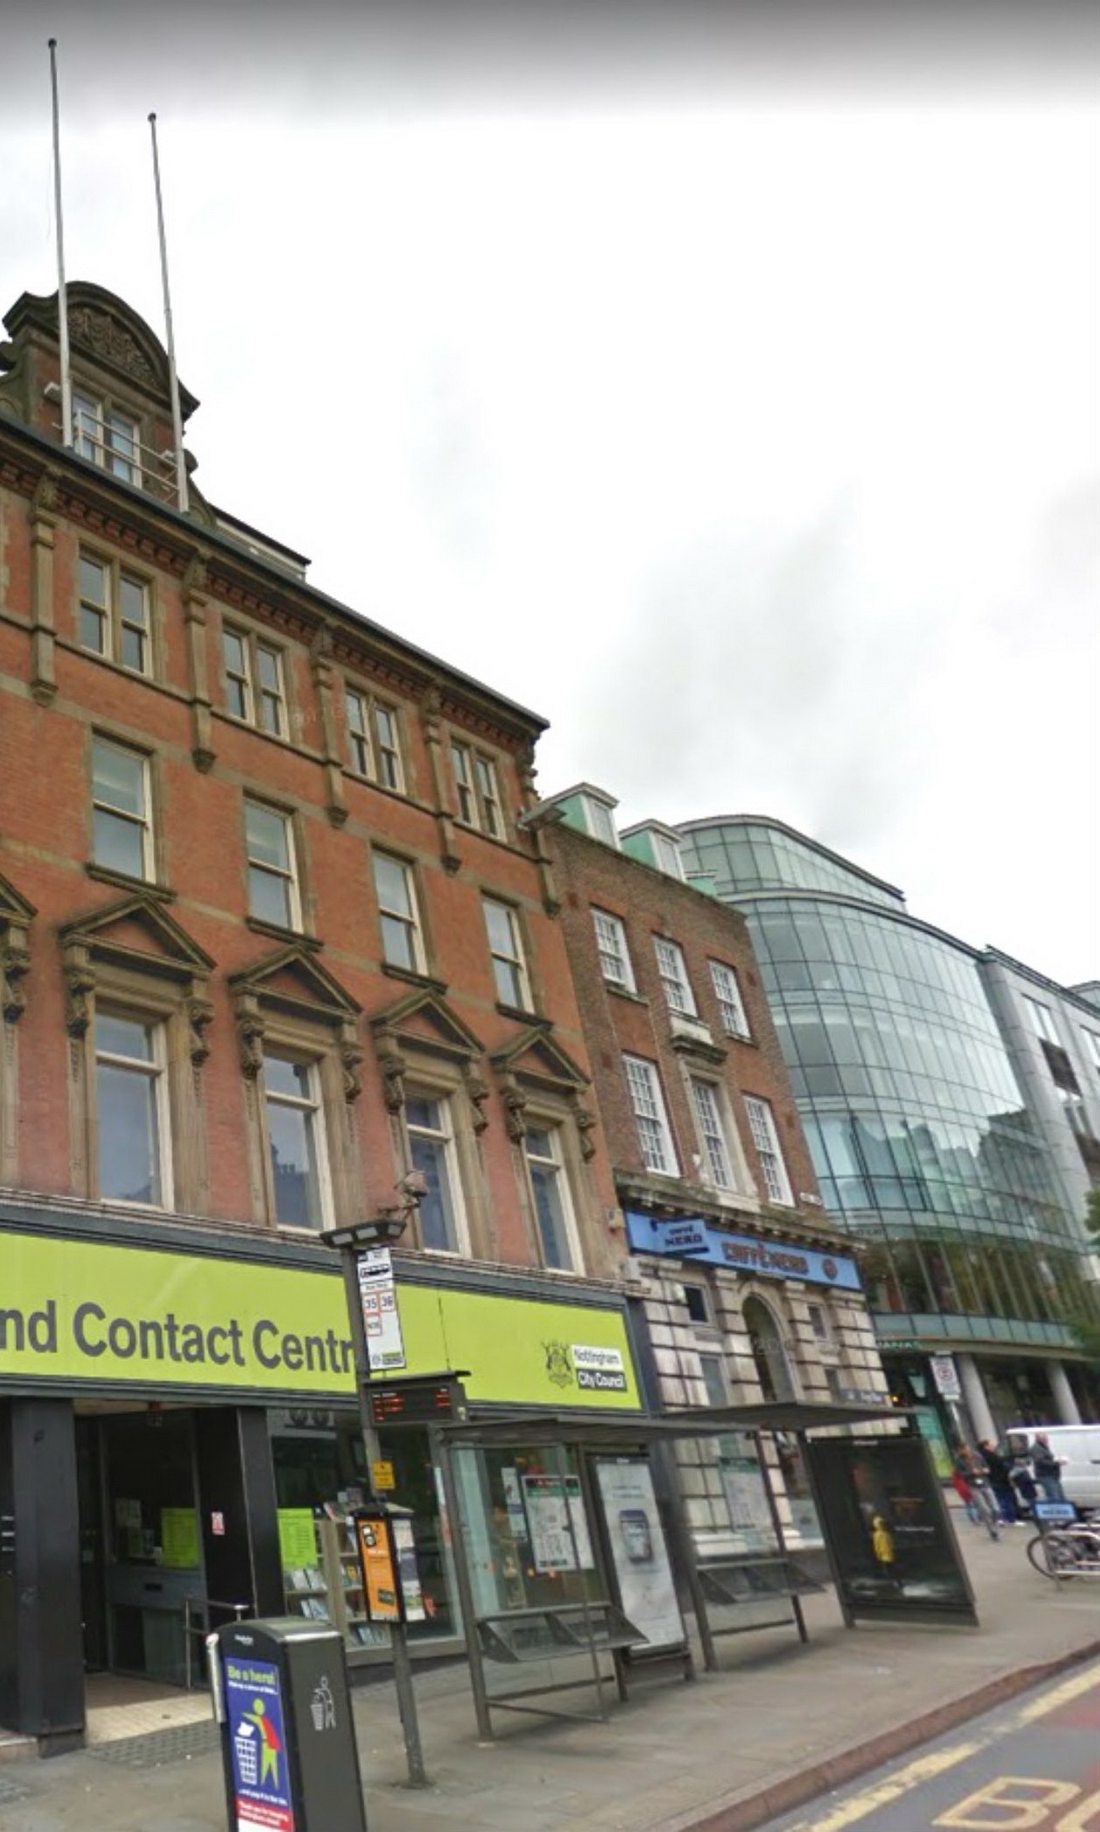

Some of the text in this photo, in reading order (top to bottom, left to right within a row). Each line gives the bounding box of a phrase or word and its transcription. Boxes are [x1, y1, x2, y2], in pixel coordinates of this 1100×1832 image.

[72, 1301, 247, 1367] Contact
[252, 1319, 358, 1374] Centr
[574, 1347, 620, 1366] Nottingham
[578, 1371, 625, 1388] City Council
[227, 1665, 241, 1680] Be
[932, 1775, 1100, 1832] B
